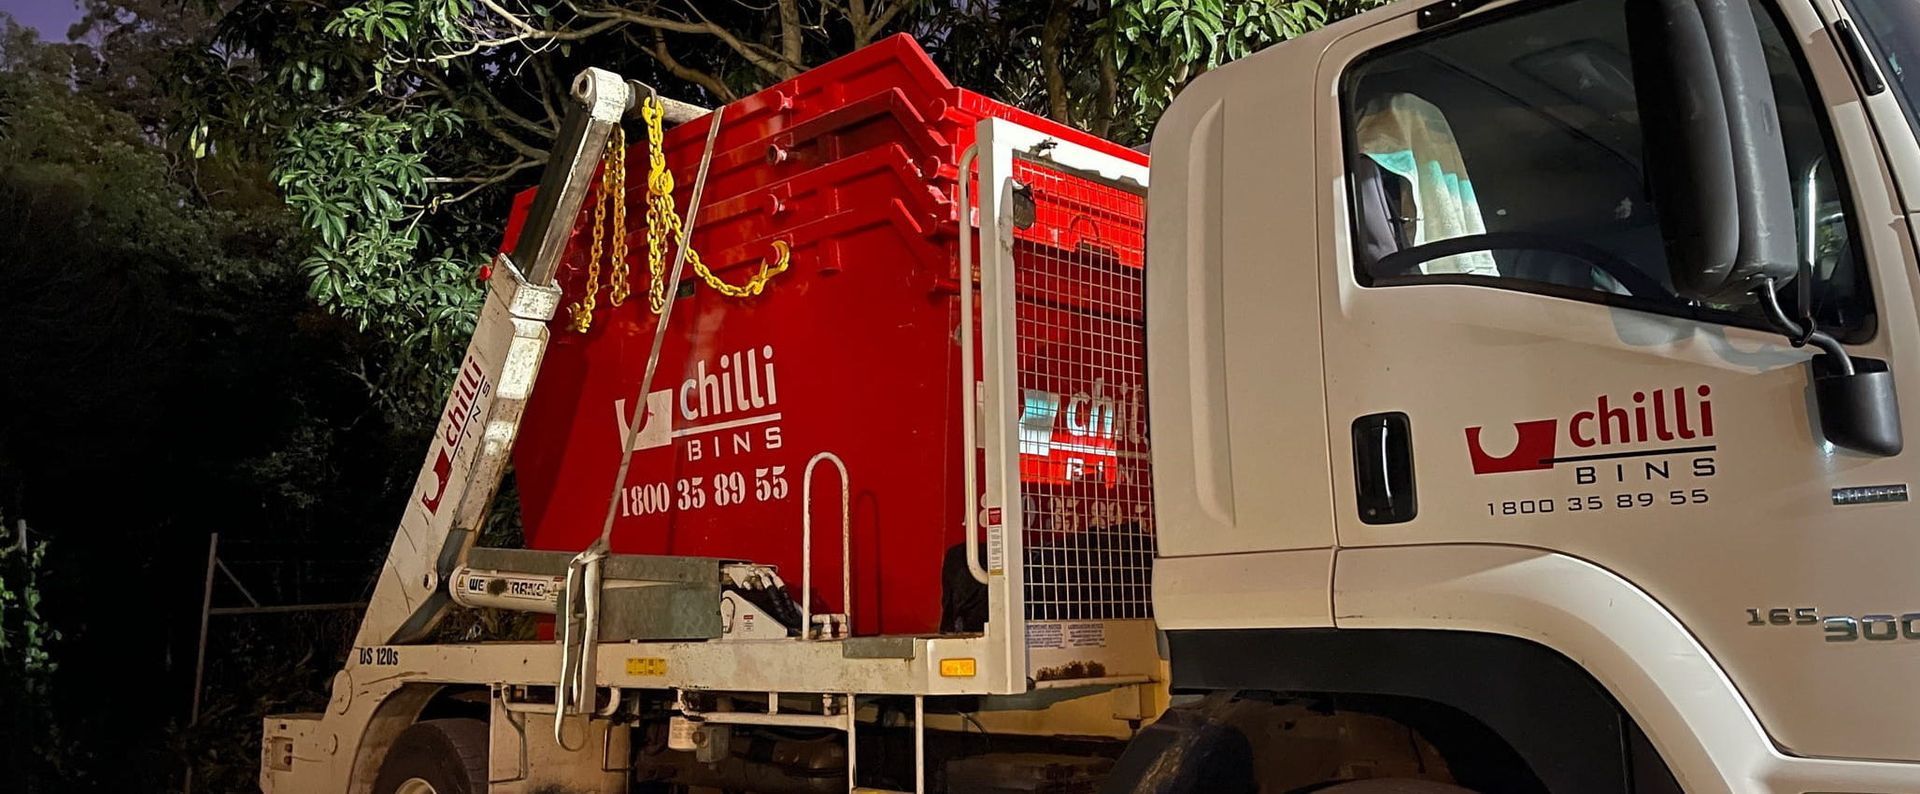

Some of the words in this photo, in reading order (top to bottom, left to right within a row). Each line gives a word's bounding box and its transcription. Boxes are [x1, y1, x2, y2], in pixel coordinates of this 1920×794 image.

[679, 344, 778, 421] chilli
[446, 355, 482, 447] chilli
[1569, 384, 1714, 448] chilli
[687, 426, 783, 462] BINS
[1576, 457, 1716, 485] BINS
[621, 482, 670, 517] 1800
[677, 476, 706, 510] 35
[714, 471, 746, 506] 89
[755, 465, 789, 501] 55
[1487, 500, 1554, 516] 1800
[1567, 496, 1603, 511] 35
[1616, 492, 1654, 508] 89
[1669, 488, 1709, 504] 55
[1746, 607, 1819, 626] 165
[360, 647, 373, 665] DS
[376, 647, 398, 666] 120s
